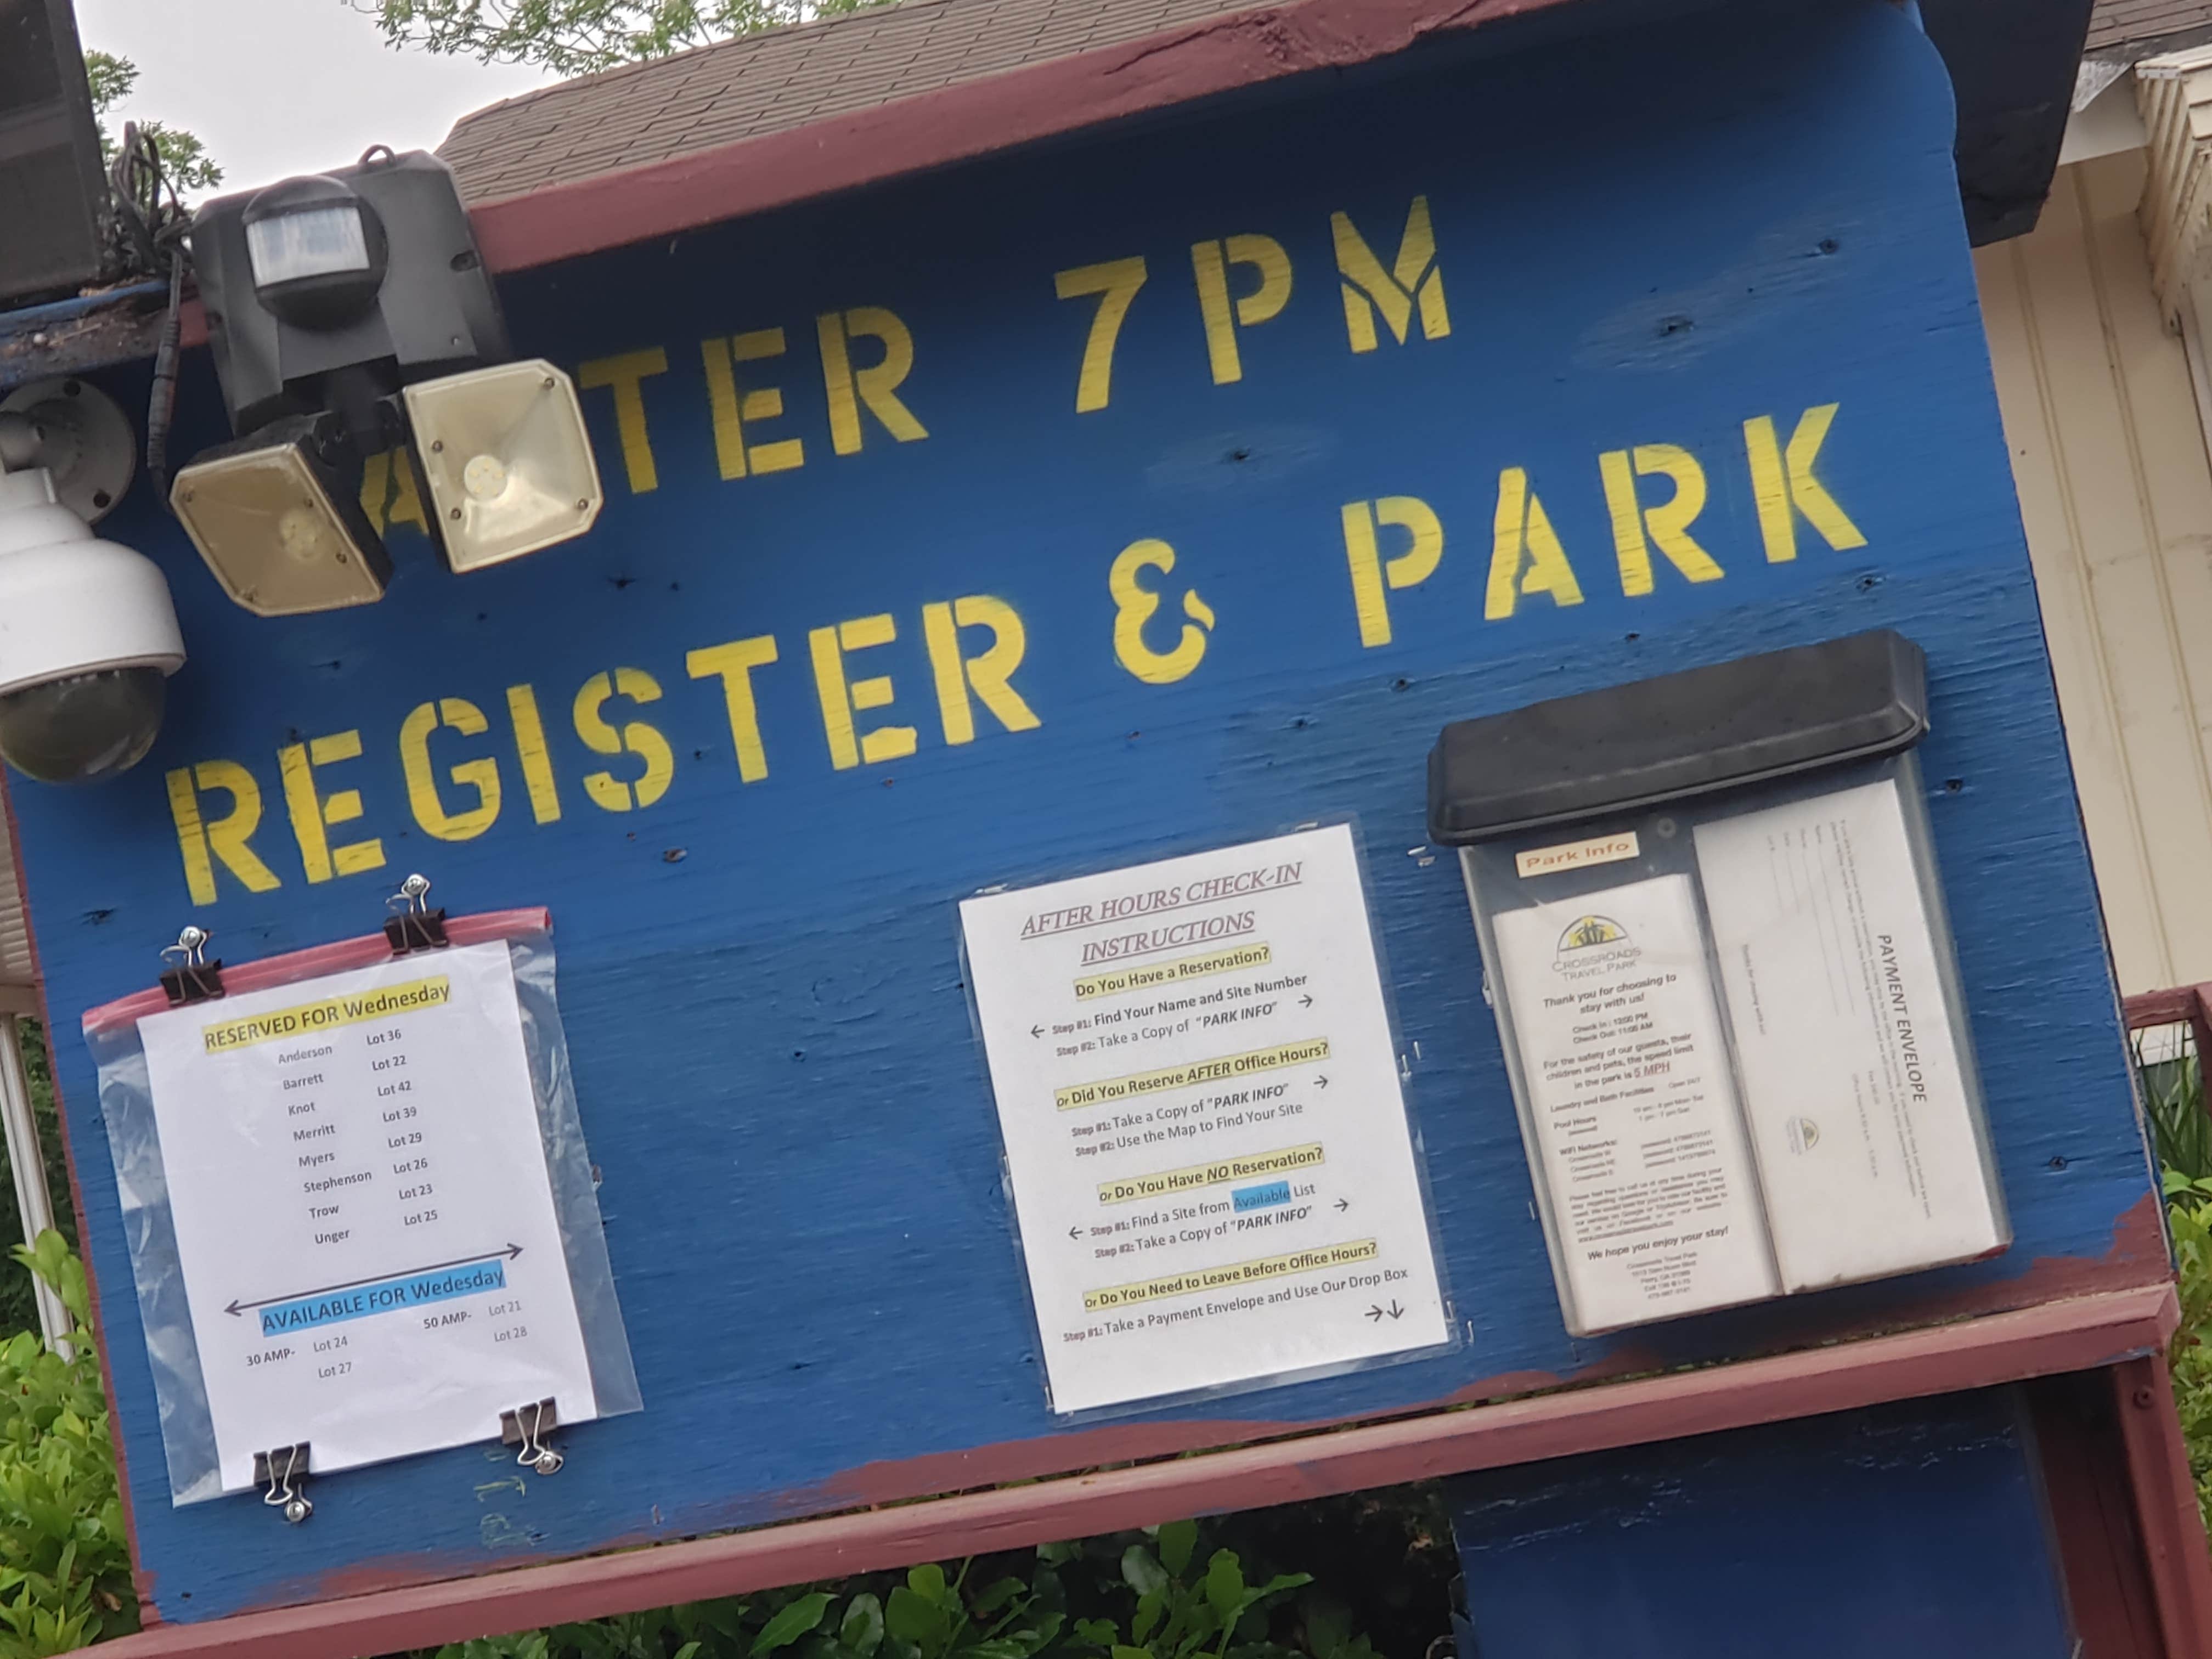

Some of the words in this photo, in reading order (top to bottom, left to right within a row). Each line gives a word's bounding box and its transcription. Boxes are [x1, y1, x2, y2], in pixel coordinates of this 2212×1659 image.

[359, 307, 927, 542] ATER
[168, 597, 1038, 904] REGISTER
[1111, 539, 1214, 684] &
[1344, 405, 1866, 647] PARK
[1525, 850, 1579, 870] Park
[1584, 842, 1630, 859] Info
[1020, 905, 1095, 936] AFTER
[1098, 886, 1182, 921] HOURS
[1186, 861, 1303, 902] CHECK-IN
[1080, 910, 1255, 963] INSTRUCTIONS
[1074, 984, 1096, 997] Do
[1097, 978, 1126, 993] You
[1128, 970, 1164, 987] Have
[1167, 968, 1176, 979] a
[1178, 946, 1269, 977] Reservation?
[1542, 993, 1576, 1009] Thank
[1577, 990, 1597, 1005] you
[1598, 986, 1615, 997] for
[1616, 976, 1664, 994] choosing
[1665, 973, 1677, 984] to
[205, 1015, 297, 1050] RESERVED
[301, 1006, 340, 1028] FOR
[342, 984, 450, 1018] Wednesday
[1052, 1024, 1075, 1035] Step
[1093, 1008, 1122, 1026] Find
[1123, 1005, 1155, 1021] Your
[1156, 998, 1197, 1014] Name
[1199, 988, 1224, 1006] and
[1226, 986, 1252, 1000] Site
[1254, 975, 1308, 995] Number
[1579, 1002, 1602, 1015] stay
[1603, 996, 1627, 1009] with
[1628, 991, 1645, 1005] us!
[1877, 934, 1909, 1015] PAYMENT
[1896, 1019, 1928, 1103] ENVELOPE
[278, 1045, 333, 1065] Anderson
[366, 1032, 386, 1046] Lot
[387, 1028, 402, 1041] 36
[1057, 1046, 1079, 1057] Step
[1097, 1032, 1128, 1048] Take
[1131, 1032, 1139, 1042] a
[1141, 1024, 1173, 1040] Copy
[1176, 1018, 1189, 1033] of
[282, 1073, 324, 1091] Barrett
[371, 1058, 391, 1071] Lot
[392, 1054, 407, 1067] 22
[1056, 1097, 1069, 1108] or
[1071, 1087, 1096, 1104] Did
[1097, 1084, 1125, 1099] You
[1127, 1073, 1184, 1093] Reserve
[1186, 1061, 1231, 1082] AFTER
[1234, 1054, 1276, 1072] Office
[1278, 1042, 1329, 1064] Hours?
[1633, 1066, 1641, 1079] 5
[1643, 1060, 1671, 1077] MPH
[287, 1101, 316, 1117] Knot
[376, 1084, 396, 1097] Lot
[397, 1080, 413, 1092] 42
[1111, 1113, 1143, 1129] Take
[1146, 1112, 1154, 1122] a
[1155, 1105, 1188, 1120] Copy
[1190, 1098, 1204, 1114] of
[292, 1124, 336, 1142] Merritt
[382, 1110, 402, 1123] Lot
[402, 1106, 417, 1119] 39
[1115, 1136, 1141, 1148] Use
[1143, 1130, 1165, 1144] the
[1167, 1124, 1197, 1139] Map
[1199, 1121, 1214, 1133] to
[1216, 1112, 1244, 1130] Find
[1244, 1108, 1276, 1124] Your
[1278, 1104, 1303, 1117] Site
[298, 1152, 336, 1168] Myers
[387, 1136, 407, 1149] Lot
[408, 1131, 422, 1144] 29
[303, 1171, 373, 1193] Stephenson
[392, 1161, 413, 1175] Lot
[413, 1157, 428, 1171] 26
[1098, 1192, 1113, 1202] or
[1114, 1186, 1135, 1199] Do
[1136, 1180, 1165, 1194] You
[1167, 1173, 1204, 1189] Have
[1206, 1165, 1229, 1182] NO
[1232, 1146, 1323, 1177] Reservation?
[308, 1205, 340, 1220] Trow
[398, 1187, 418, 1200] Lot
[418, 1183, 433, 1197] 23
[1131, 1211, 1159, 1229] Find
[1161, 1213, 1170, 1223] a
[1171, 1207, 1197, 1221] Site
[1198, 1201, 1231, 1216] from
[1233, 1183, 1291, 1210] Available
[1293, 1183, 1316, 1198] List
[314, 1229, 350, 1245] Unger
[403, 1213, 423, 1227] Lot
[423, 1209, 438, 1222] 25
[1134, 1235, 1166, 1251] Take
[1169, 1234, 1177, 1244] a
[1178, 1227, 1211, 1243] Copy
[1214, 1221, 1228, 1236] of
[1587, 1250, 1603, 1261] We
[1604, 1246, 1630, 1258] hope
[1631, 1241, 1651, 1255] you
[1651, 1237, 1679, 1249] enjoy
[1680, 1232, 1704, 1245] your
[1705, 1224, 1729, 1238] stay!
[1084, 1298, 1097, 1308] or
[1099, 1293, 1119, 1306] Do
[1119, 1288, 1146, 1302] You
[1148, 1277, 1183, 1296] Need
[1185, 1278, 1200, 1289] to
[1202, 1271, 1240, 1286] Leave
[1243, 1262, 1287, 1278] Before
[1289, 1253, 1328, 1269] Office
[1330, 1242, 1376, 1262] Hours?
[262, 1295, 364, 1333] AVAILABLE
[368, 1286, 407, 1309] FOR
[410, 1269, 504, 1300] Wedesday
[1103, 1318, 1135, 1335] Take
[1137, 1318, 1146, 1329] a
[1147, 1306, 1205, 1327] Payment
[1205, 1296, 1265, 1316] Envelope
[1267, 1287, 1291, 1304] and
[1293, 1285, 1319, 1299] Use
[1321, 1280, 1347, 1294] Our
[1348, 1274, 1381, 1289] Drop
[1383, 1269, 1408, 1282] Box
[246, 1353, 262, 1367] 30
[263, 1347, 296, 1363] AMP-
[313, 1339, 332, 1353] Lot
[332, 1335, 348, 1348] 24
[423, 1316, 439, 1330] 50
[441, 1311, 472, 1327] AMP-
[488, 1304, 506, 1317] Lot
[507, 1300, 522, 1313] 21
[318, 1365, 337, 1379] Lot
[337, 1361, 352, 1375] 27
[493, 1329, 512, 1343] Lot
[512, 1325, 528, 1339] 28
